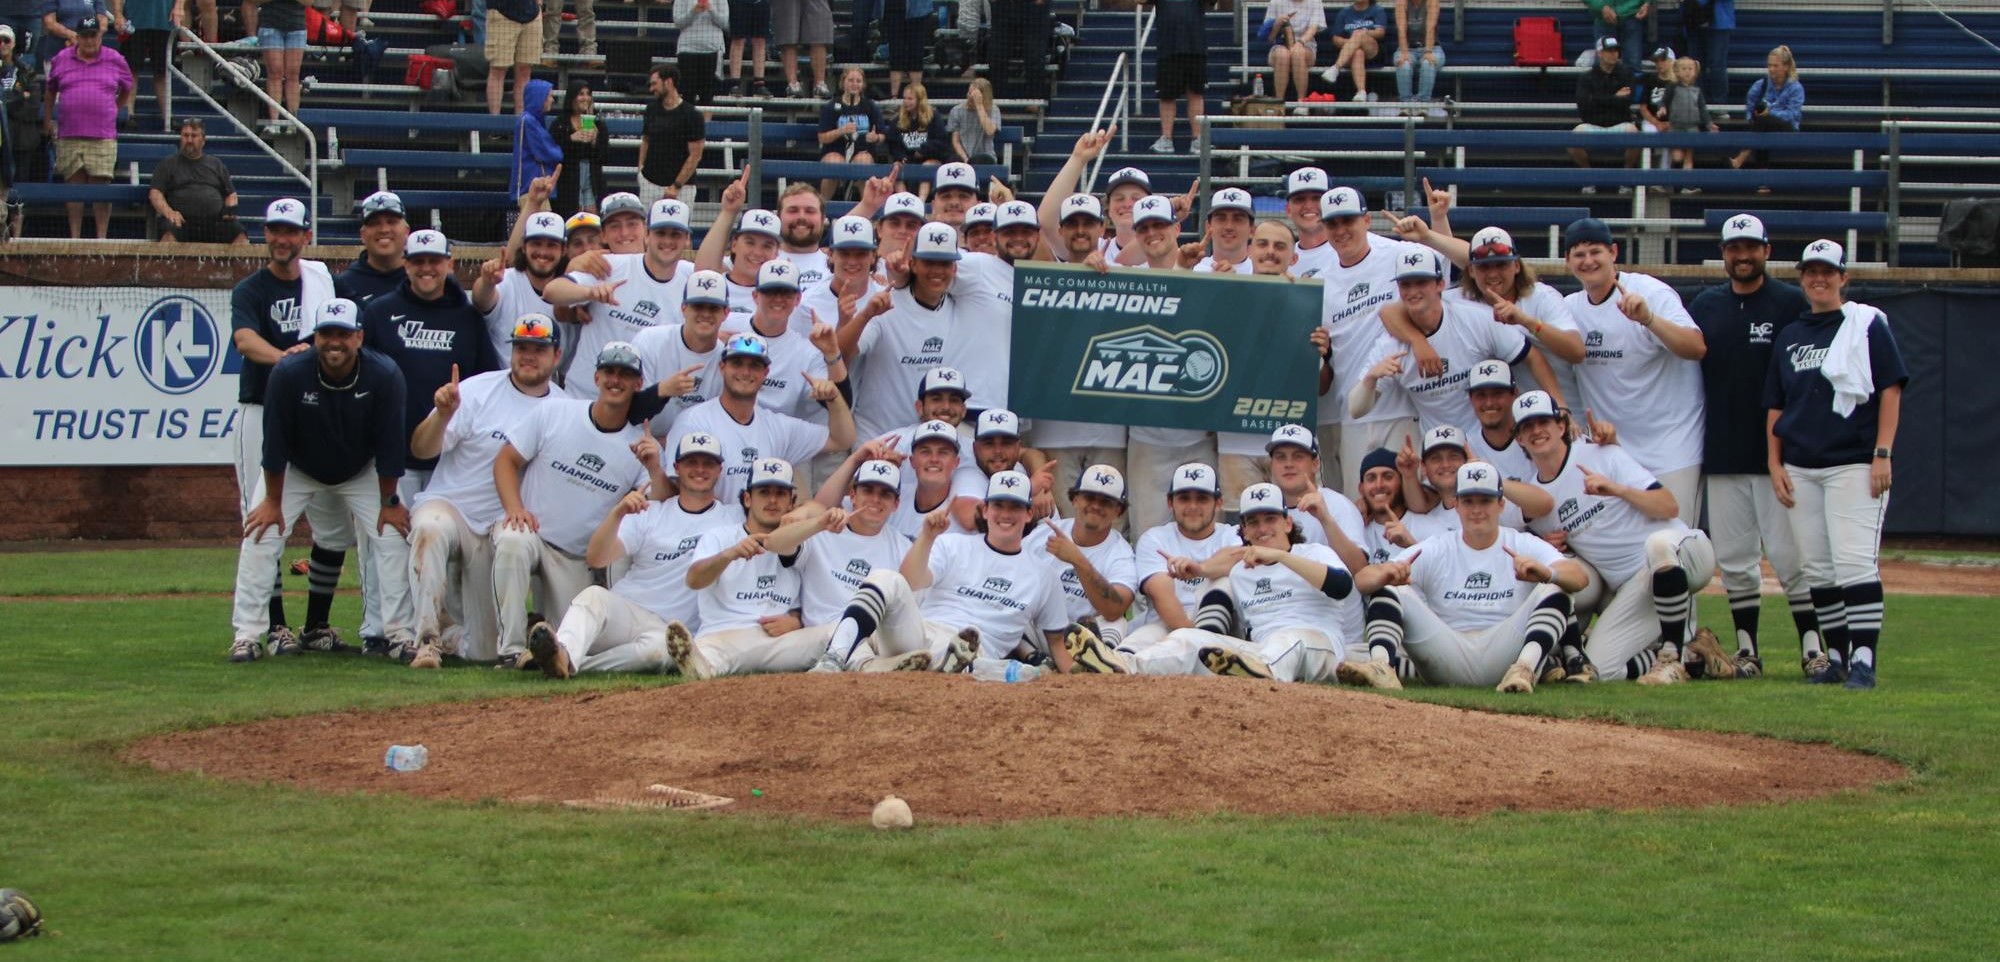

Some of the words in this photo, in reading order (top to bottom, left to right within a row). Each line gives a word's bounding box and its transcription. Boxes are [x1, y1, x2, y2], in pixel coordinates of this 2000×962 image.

[946, 168, 965, 178] LVC
[1298, 172, 1318, 182] LVC
[896, 197, 915, 206] LVC
[1071, 196, 1090, 206] LVC
[1222, 192, 1242, 202] LVC
[1328, 193, 1348, 205] LVC
[274, 204, 294, 214] LVC
[1140, 199, 1160, 210] LVC
[662, 206, 680, 216] LVC
[974, 206, 991, 216] LVC
[1008, 205, 1026, 216] LVC
[536, 217, 554, 227] LVC
[754, 215, 774, 226] LVC
[1732, 218, 1752, 230] LVC
[844, 222, 864, 234] LVC
[416, 235, 435, 244] LVC
[930, 232, 948, 245] LVC
[1811, 242, 1830, 252] LVC
[1404, 253, 1424, 265] LVC
[770, 265, 790, 276] LVC
[697, 278, 717, 290] LVC
[1024, 276, 1050, 286] MAC
[1058, 278, 1168, 292] COMMONWEALTH
[1022, 288, 1182, 316] CHAMPIONS
[1332, 291, 1394, 322] CHAMPIONS
[326, 304, 346, 314] LVC
[403, 320, 456, 345] VALLEY
[1750, 322, 1774, 336] LVC
[404, 340, 453, 350] BASEBALL
[938, 370, 958, 380] LVC
[1480, 364, 1498, 376] LVC
[1082, 360, 1180, 392] MAC
[1520, 396, 1538, 408] LVC
[1233, 398, 1308, 418] 2022
[990, 412, 1008, 424] LVC
[32, 408, 150, 440] TRUST
[156, 408, 190, 440] IS
[928, 422, 946, 432] LVC
[1282, 427, 1301, 436] LVC
[1436, 428, 1455, 438] LVC
[692, 435, 711, 445] LVC
[763, 462, 782, 474] LVC
[872, 463, 892, 475] LVC
[551, 460, 620, 492] CHAMPIONS
[1096, 472, 1115, 485] LVC
[1184, 469, 1204, 480] LVC
[1466, 470, 1488, 481] LVC
[1000, 476, 1020, 488] LVC
[1250, 490, 1270, 500] LVC
[1466, 580, 1490, 589] MAC
[957, 586, 1026, 610] CHAMPIONS
[1444, 589, 1514, 600] CHAMPIONS
